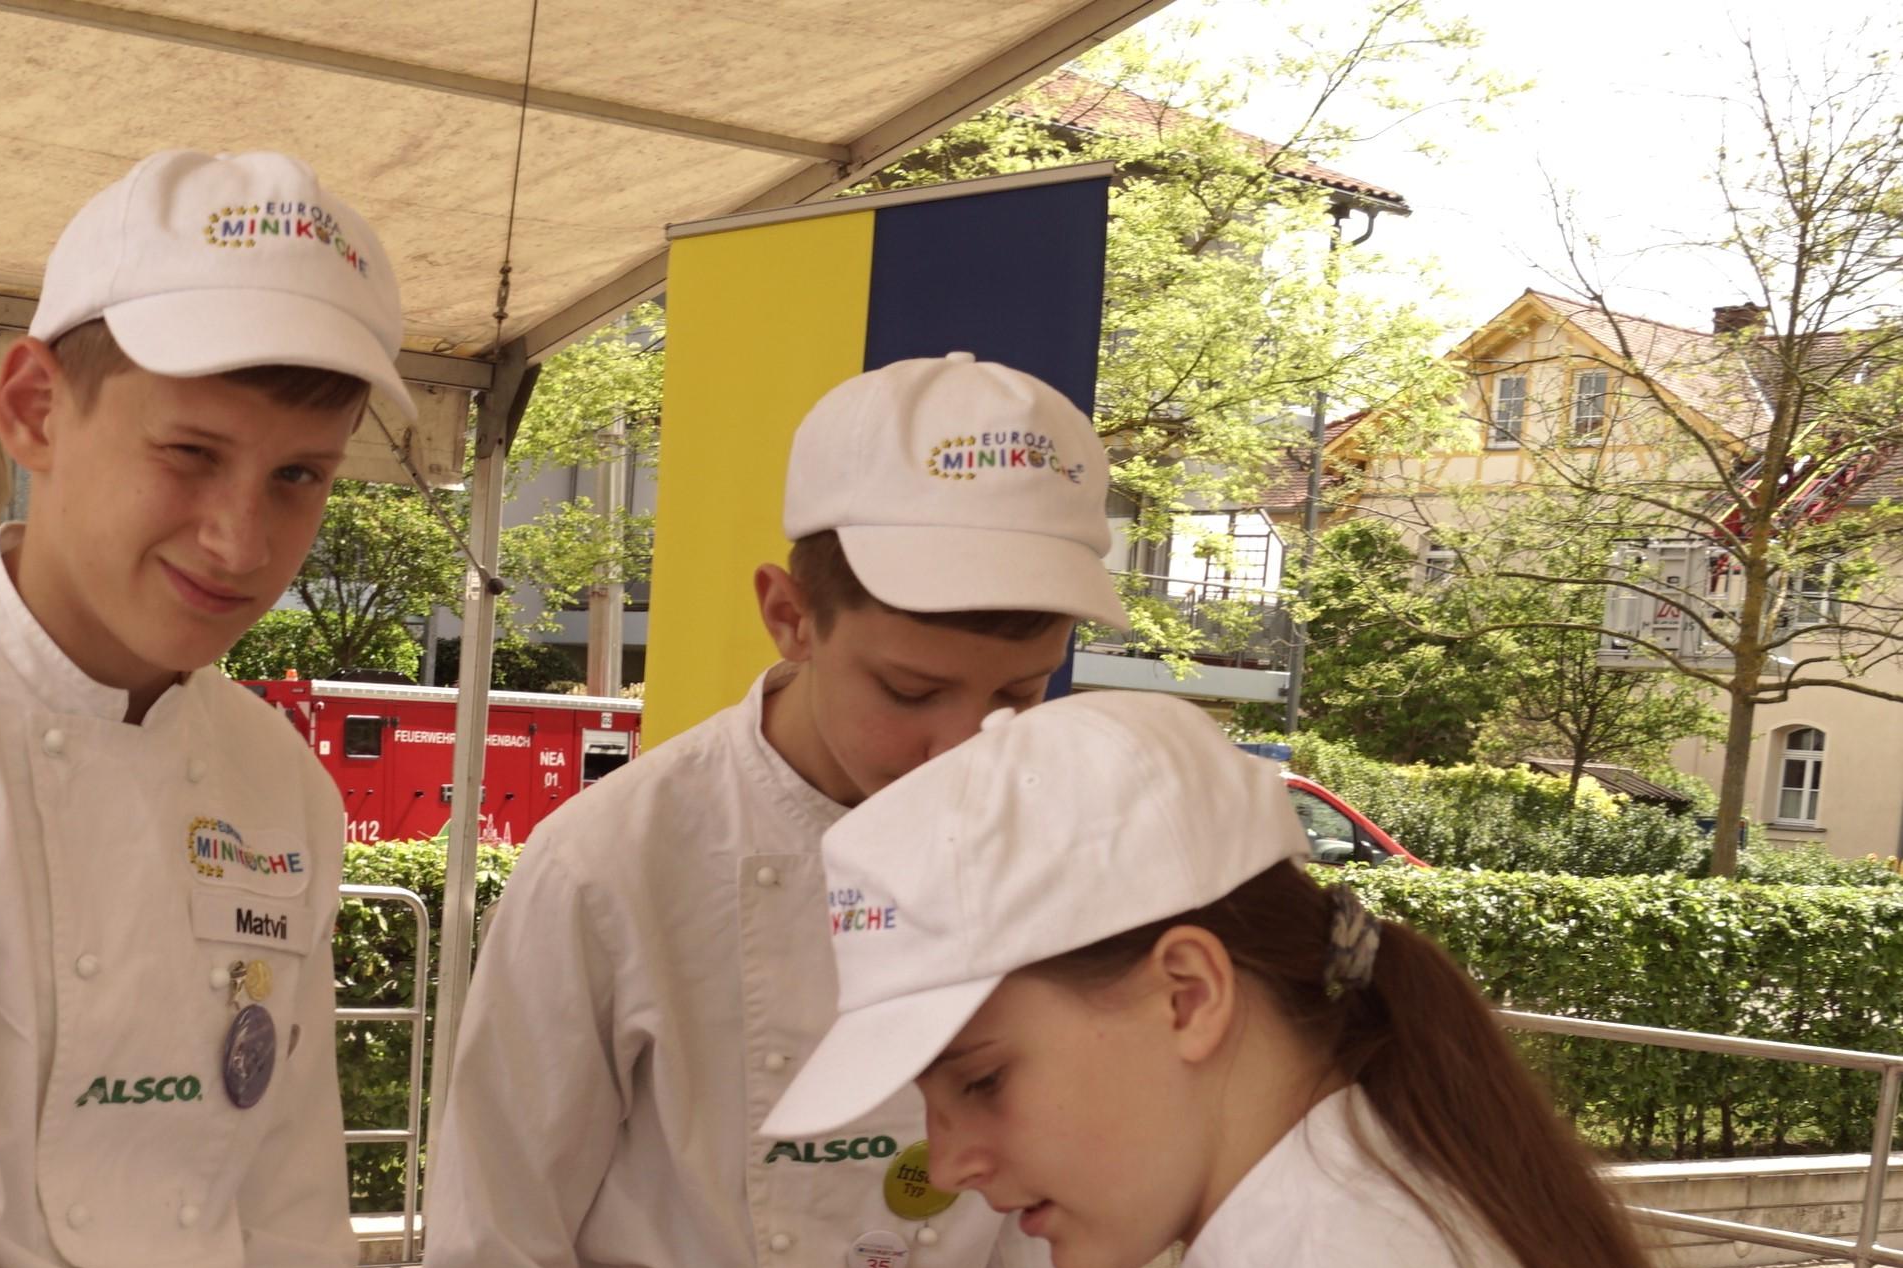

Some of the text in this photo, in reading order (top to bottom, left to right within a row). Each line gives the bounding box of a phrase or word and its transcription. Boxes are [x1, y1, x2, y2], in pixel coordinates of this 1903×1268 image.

[484, 734, 531, 747] HENBACH
[540, 752, 565, 766] NEA
[348, 820, 380, 841] 112
[75, 1075, 201, 1107] ALSCO
[765, 1135, 897, 1164] ALSCO
